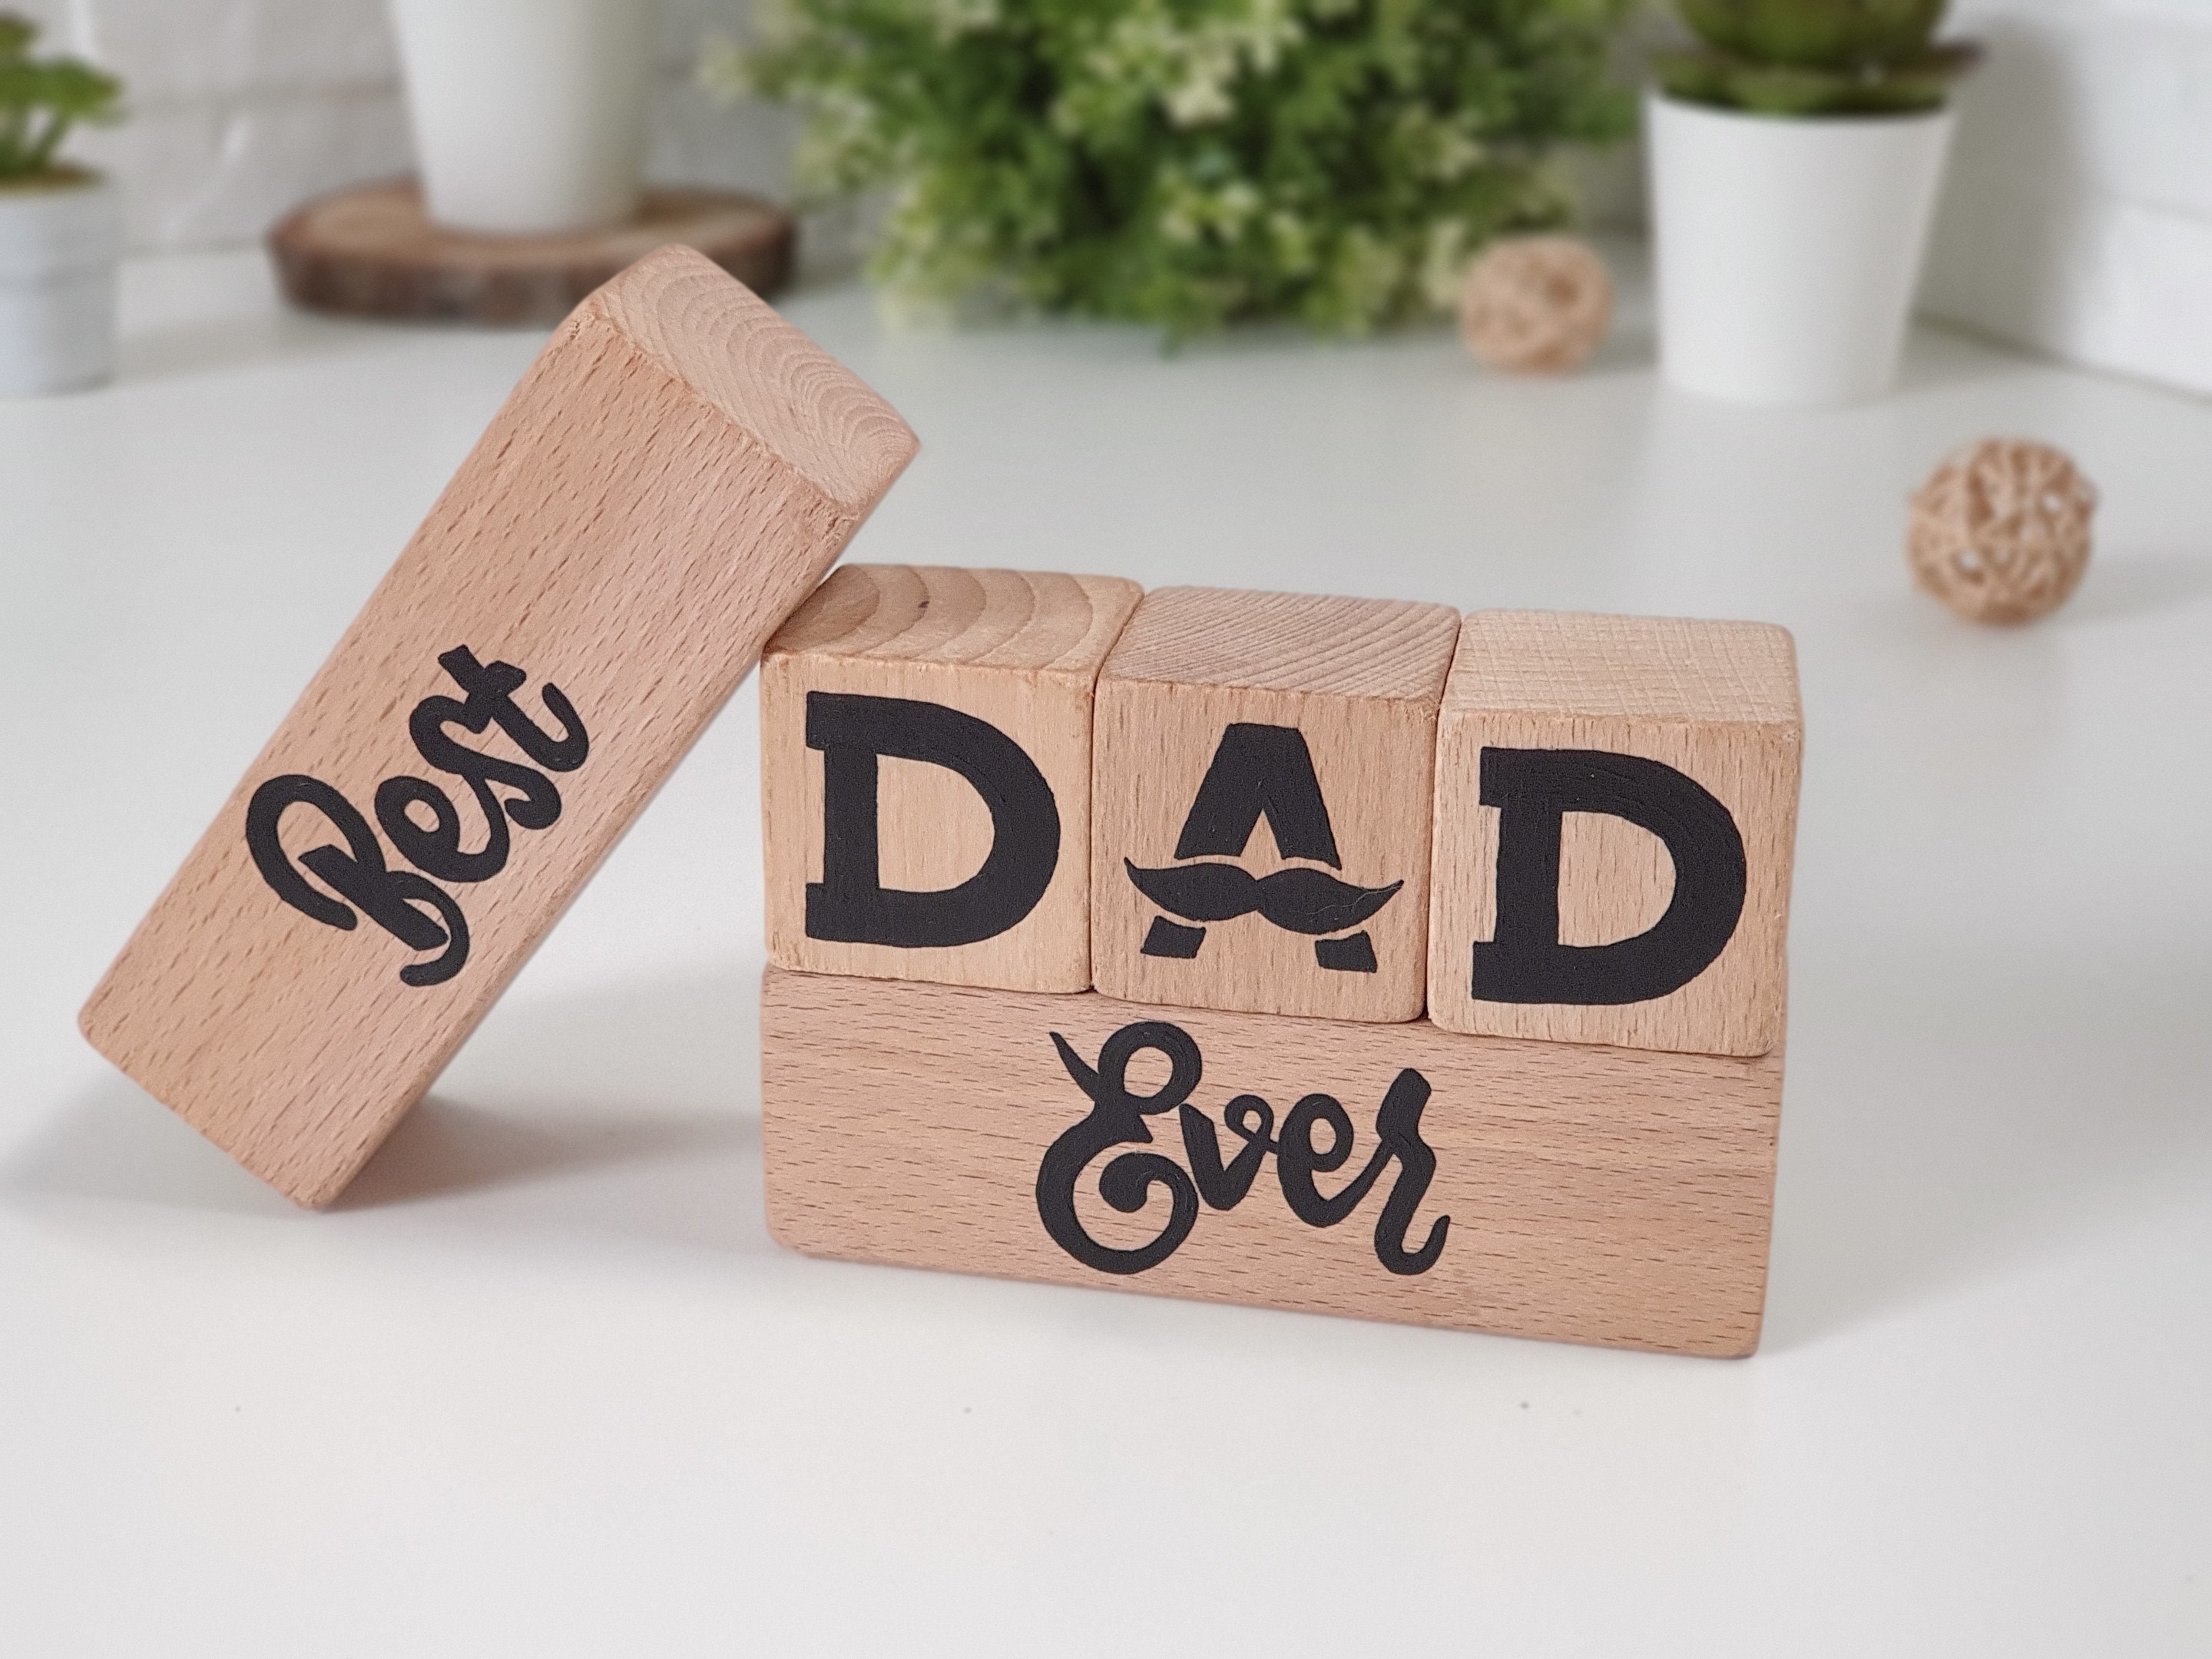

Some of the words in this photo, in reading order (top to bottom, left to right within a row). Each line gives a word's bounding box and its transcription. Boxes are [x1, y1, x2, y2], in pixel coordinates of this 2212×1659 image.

[246, 644, 590, 987] Best
[805, 690, 1748, 1006] DAD
[1036, 1021, 1451, 1276] Ever
